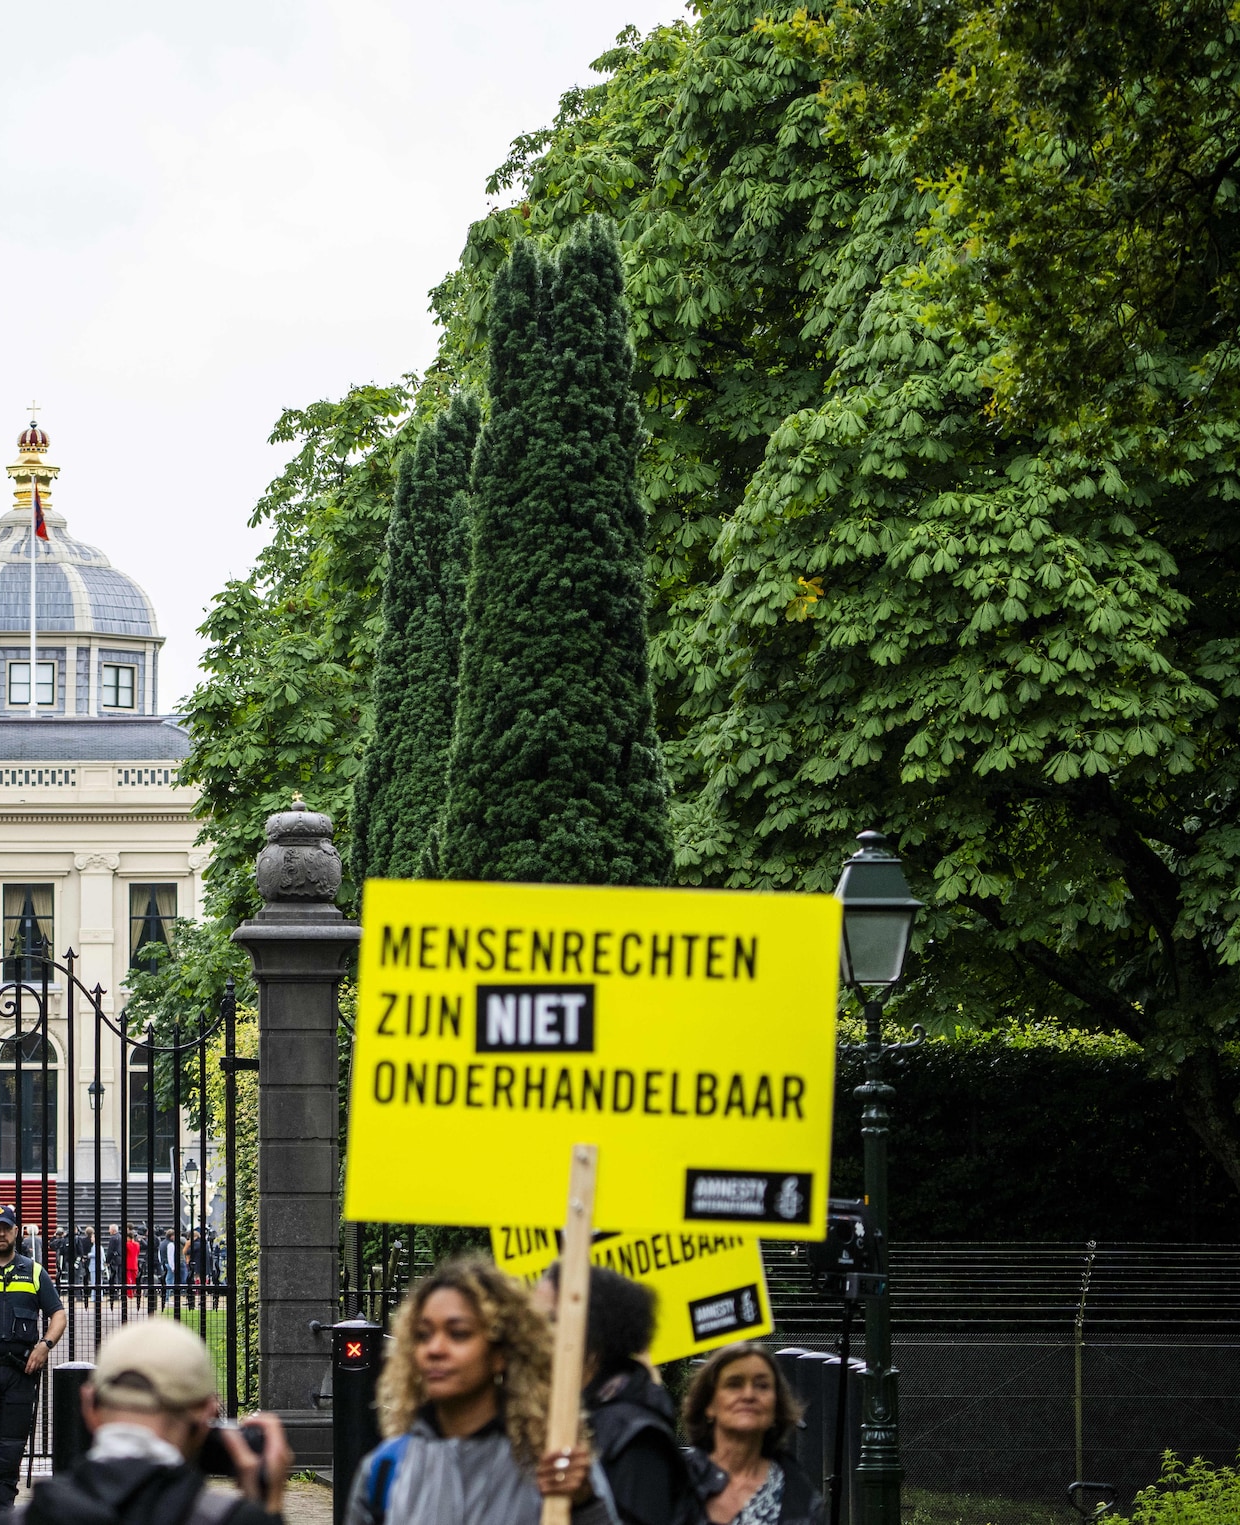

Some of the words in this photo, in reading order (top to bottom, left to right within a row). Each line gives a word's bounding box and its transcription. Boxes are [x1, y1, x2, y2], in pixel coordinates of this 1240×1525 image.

[380, 925, 757, 980] MENSENRECHTEN
[376, 992, 463, 1038] ZIJN
[486, 993, 587, 1046] NIET
[373, 1060, 806, 1120] ONDERHANDELBAAR
